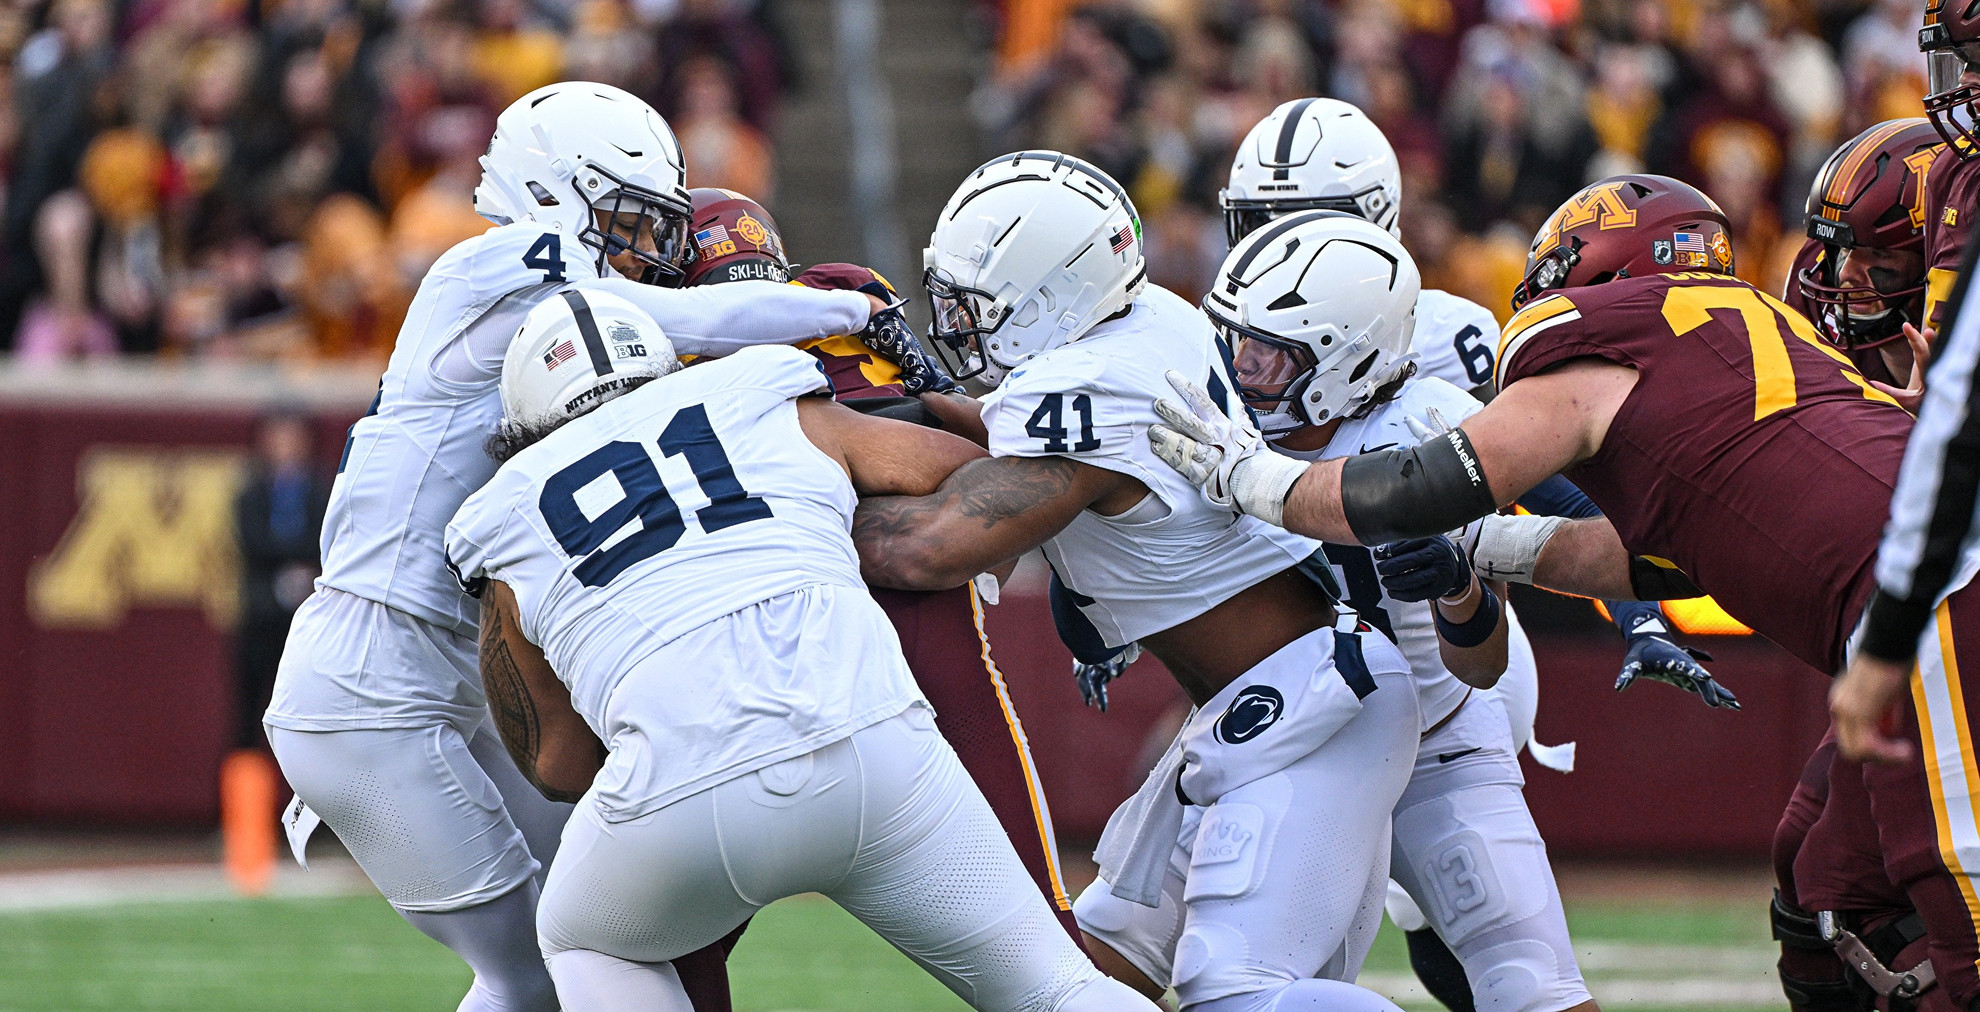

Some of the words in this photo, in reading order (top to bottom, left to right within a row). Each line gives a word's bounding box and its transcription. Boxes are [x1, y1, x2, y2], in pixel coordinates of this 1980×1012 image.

[743, 223, 761, 237] 24
[1535, 181, 1638, 261] M
[1816, 223, 1836, 239] ROW
[522, 232, 567, 282] 4
[1453, 324, 1495, 385] 6
[565, 379, 618, 413] NITTANY
[1025, 393, 1101, 452] 41
[538, 402, 774, 588] 91
[1425, 845, 1486, 926] 13
